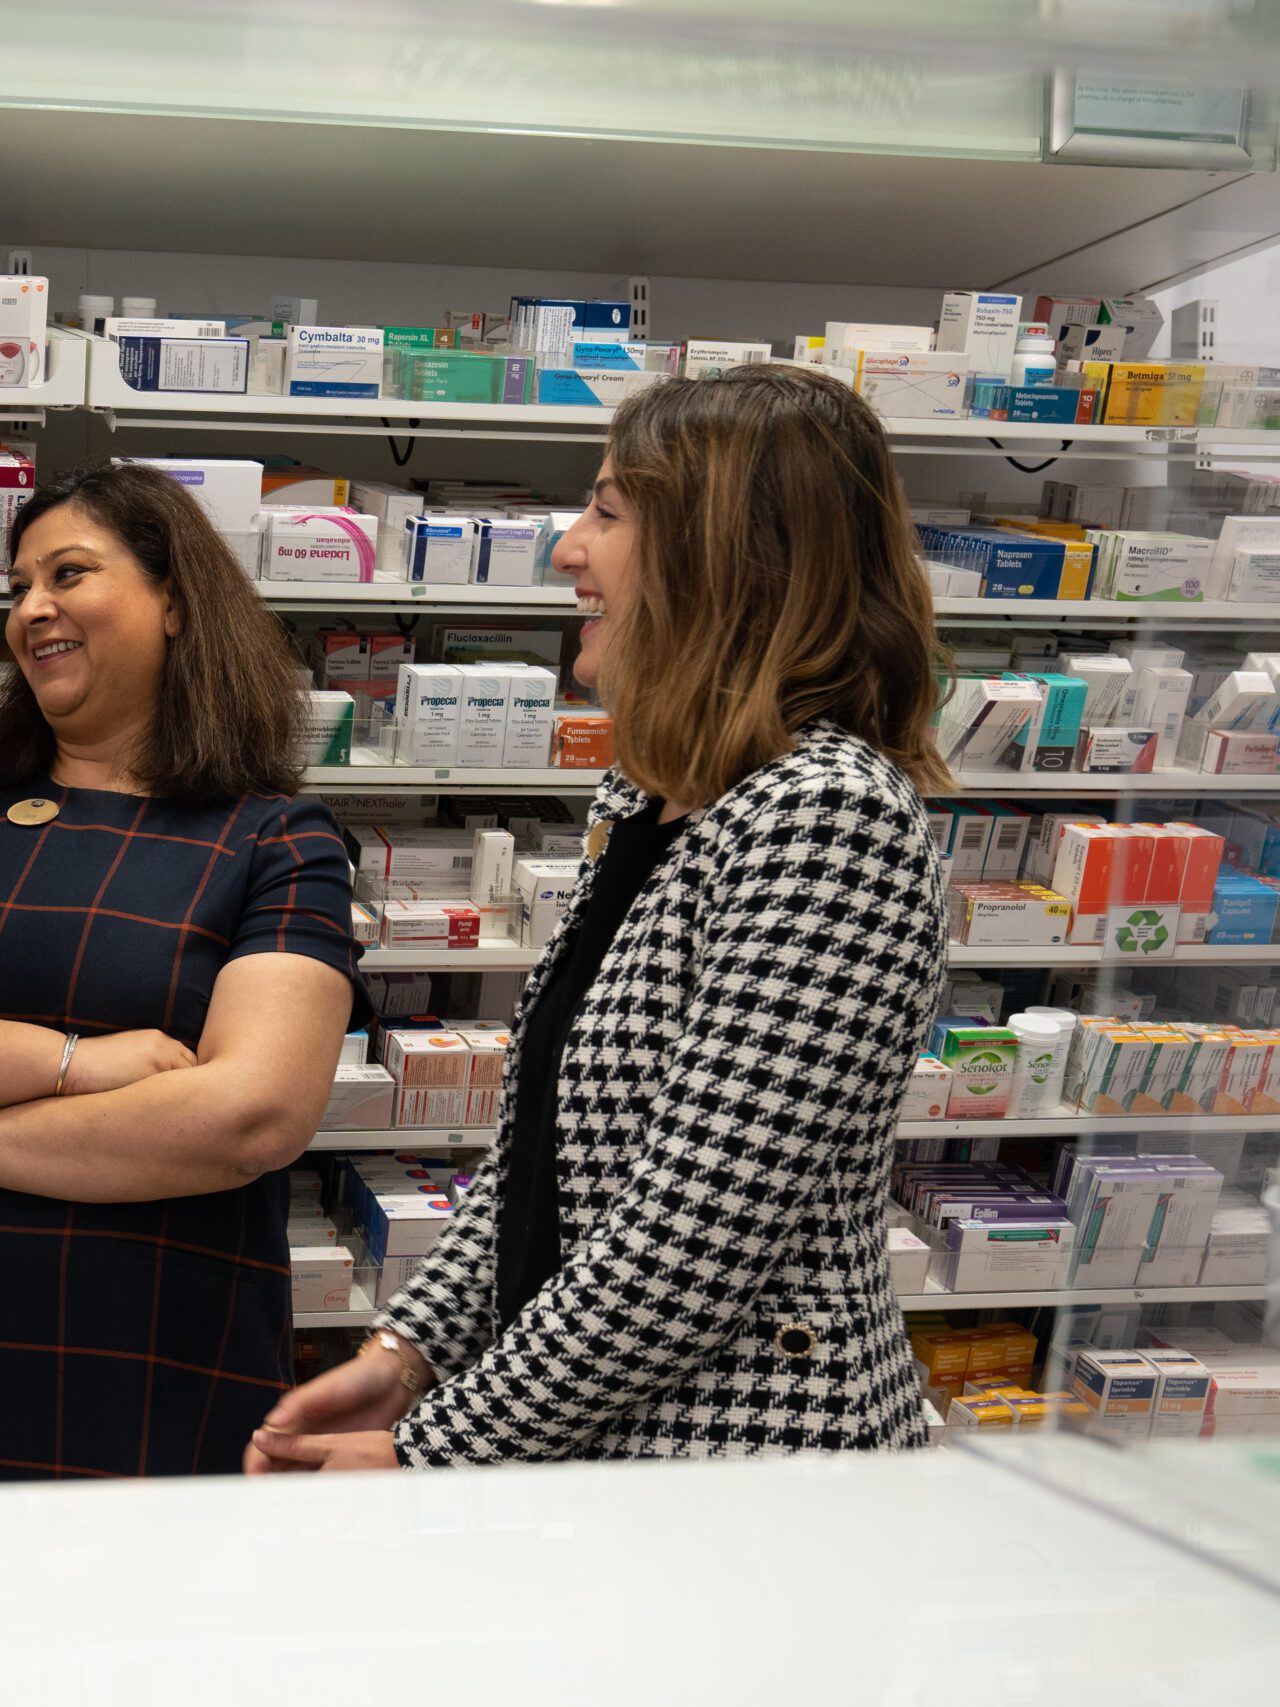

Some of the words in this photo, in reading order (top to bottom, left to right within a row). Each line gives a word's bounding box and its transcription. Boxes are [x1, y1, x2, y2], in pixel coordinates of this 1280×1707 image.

[299, 331, 353, 343] Cymbalta
[389, 333, 417, 341] Raporsin
[1127, 370, 1164, 382] Betmiga
[1178, 374, 1192, 382] mg
[1016, 392, 1058, 400] Metoclopramide
[278, 546, 293, 557] mg
[295, 549, 307, 559] 60
[310, 550, 350, 561] Lixiana
[997, 549, 1032, 560] Naproxen
[1129, 546, 1169, 555] MacroBID
[996, 560, 1022, 569] Tablets
[447, 633, 512, 644] Flucloxacillin
[420, 696, 457, 706] Propecia
[467, 697, 504, 707] Propecia
[513, 698, 550, 708] Propecia
[567, 727, 607, 735] Furosemide
[1042, 750, 1065, 768] 10
[356, 798, 407, 809] NEXThaler
[977, 903, 1026, 911] Propranolol
[1048, 906, 1058, 914] 40
[960, 1063, 1008, 1073] Senokot
[973, 1208, 998, 1219] Epilim
